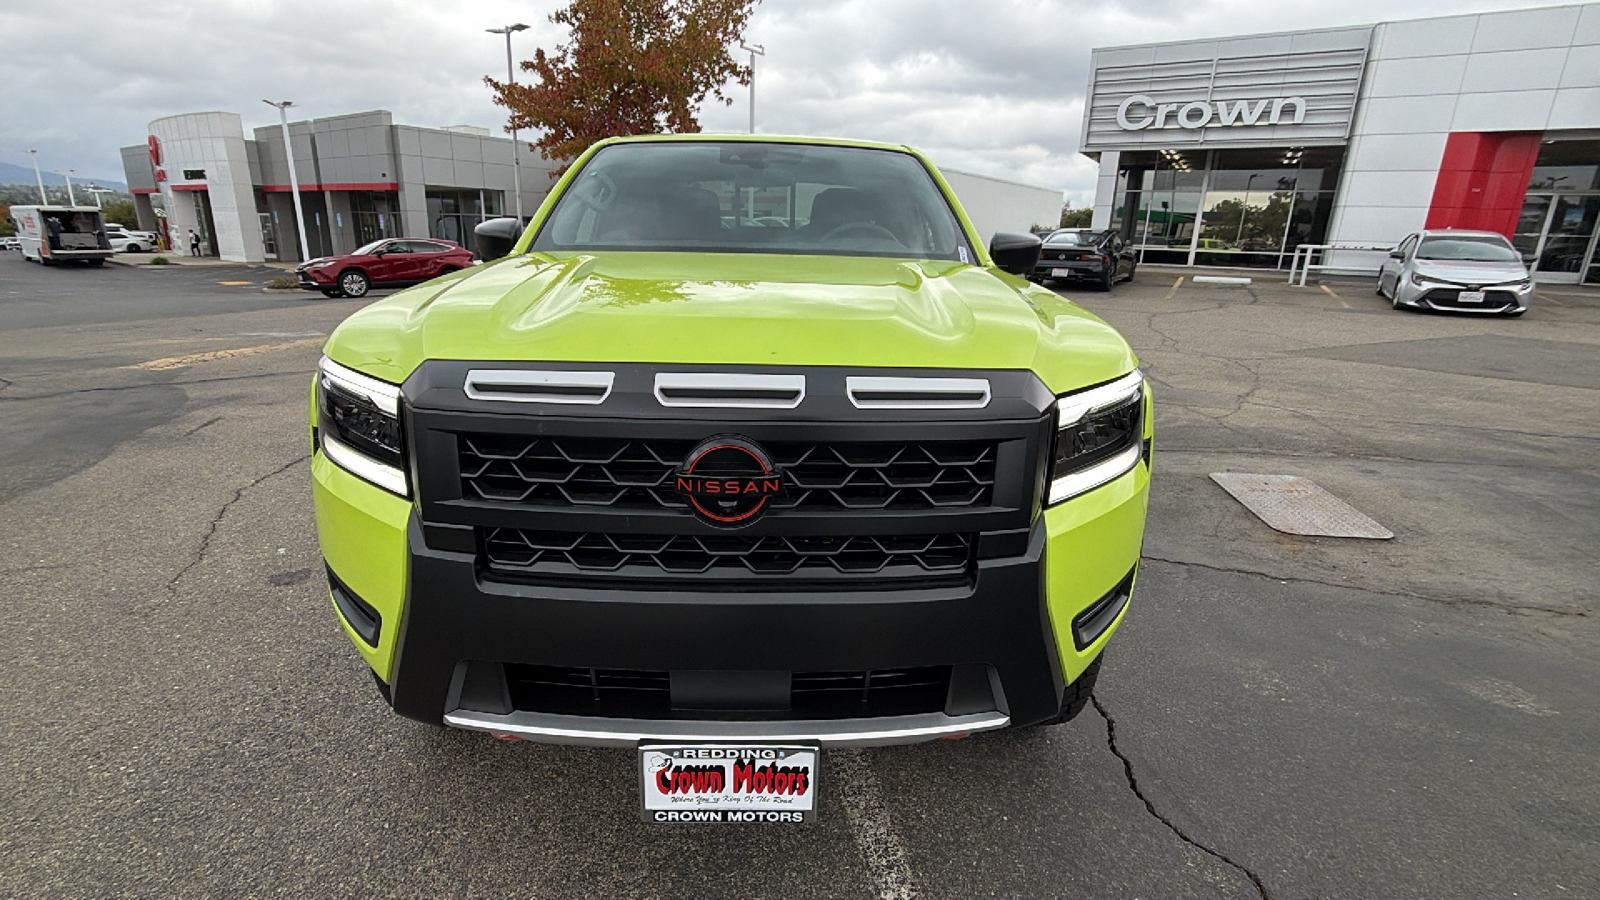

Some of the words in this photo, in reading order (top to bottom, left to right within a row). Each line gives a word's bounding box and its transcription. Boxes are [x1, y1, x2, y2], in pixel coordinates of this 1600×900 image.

[1116, 94, 1307, 131] Crown
[677, 478, 779, 493] NISSAN
[683, 750, 776, 759] REDDING
[655, 760, 725, 795] Crown
[733, 760, 809, 796] Motors
[722, 795, 741, 804] King
[773, 796, 794, 804] Road
[654, 811, 722, 822] CROWN
[727, 811, 803, 822] MOTORS
